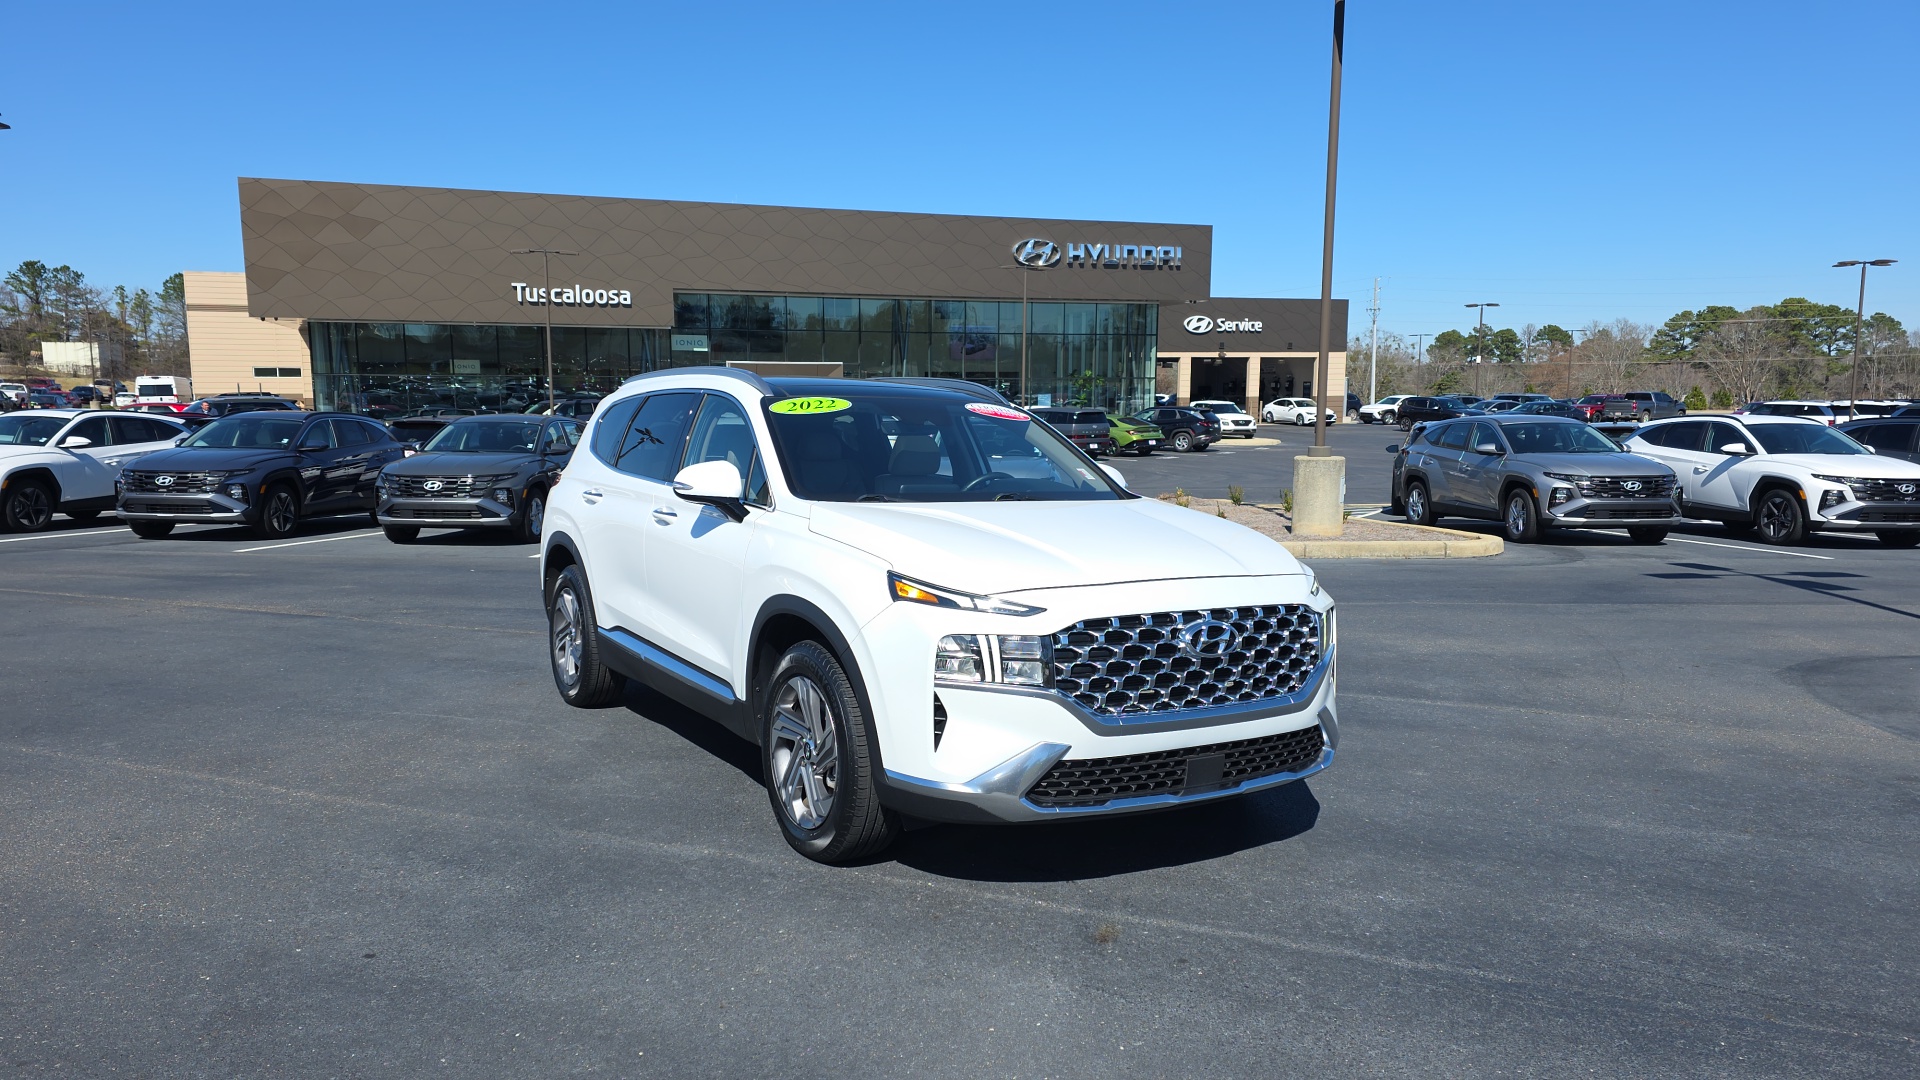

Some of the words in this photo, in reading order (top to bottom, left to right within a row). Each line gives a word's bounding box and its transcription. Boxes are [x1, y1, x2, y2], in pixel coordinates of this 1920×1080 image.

[1066, 243, 1182, 266] HYUNDAI
[511, 282, 631, 305] Tuscaloosa
[1216, 318, 1263, 332] Service
[786, 399, 837, 412] 2022
